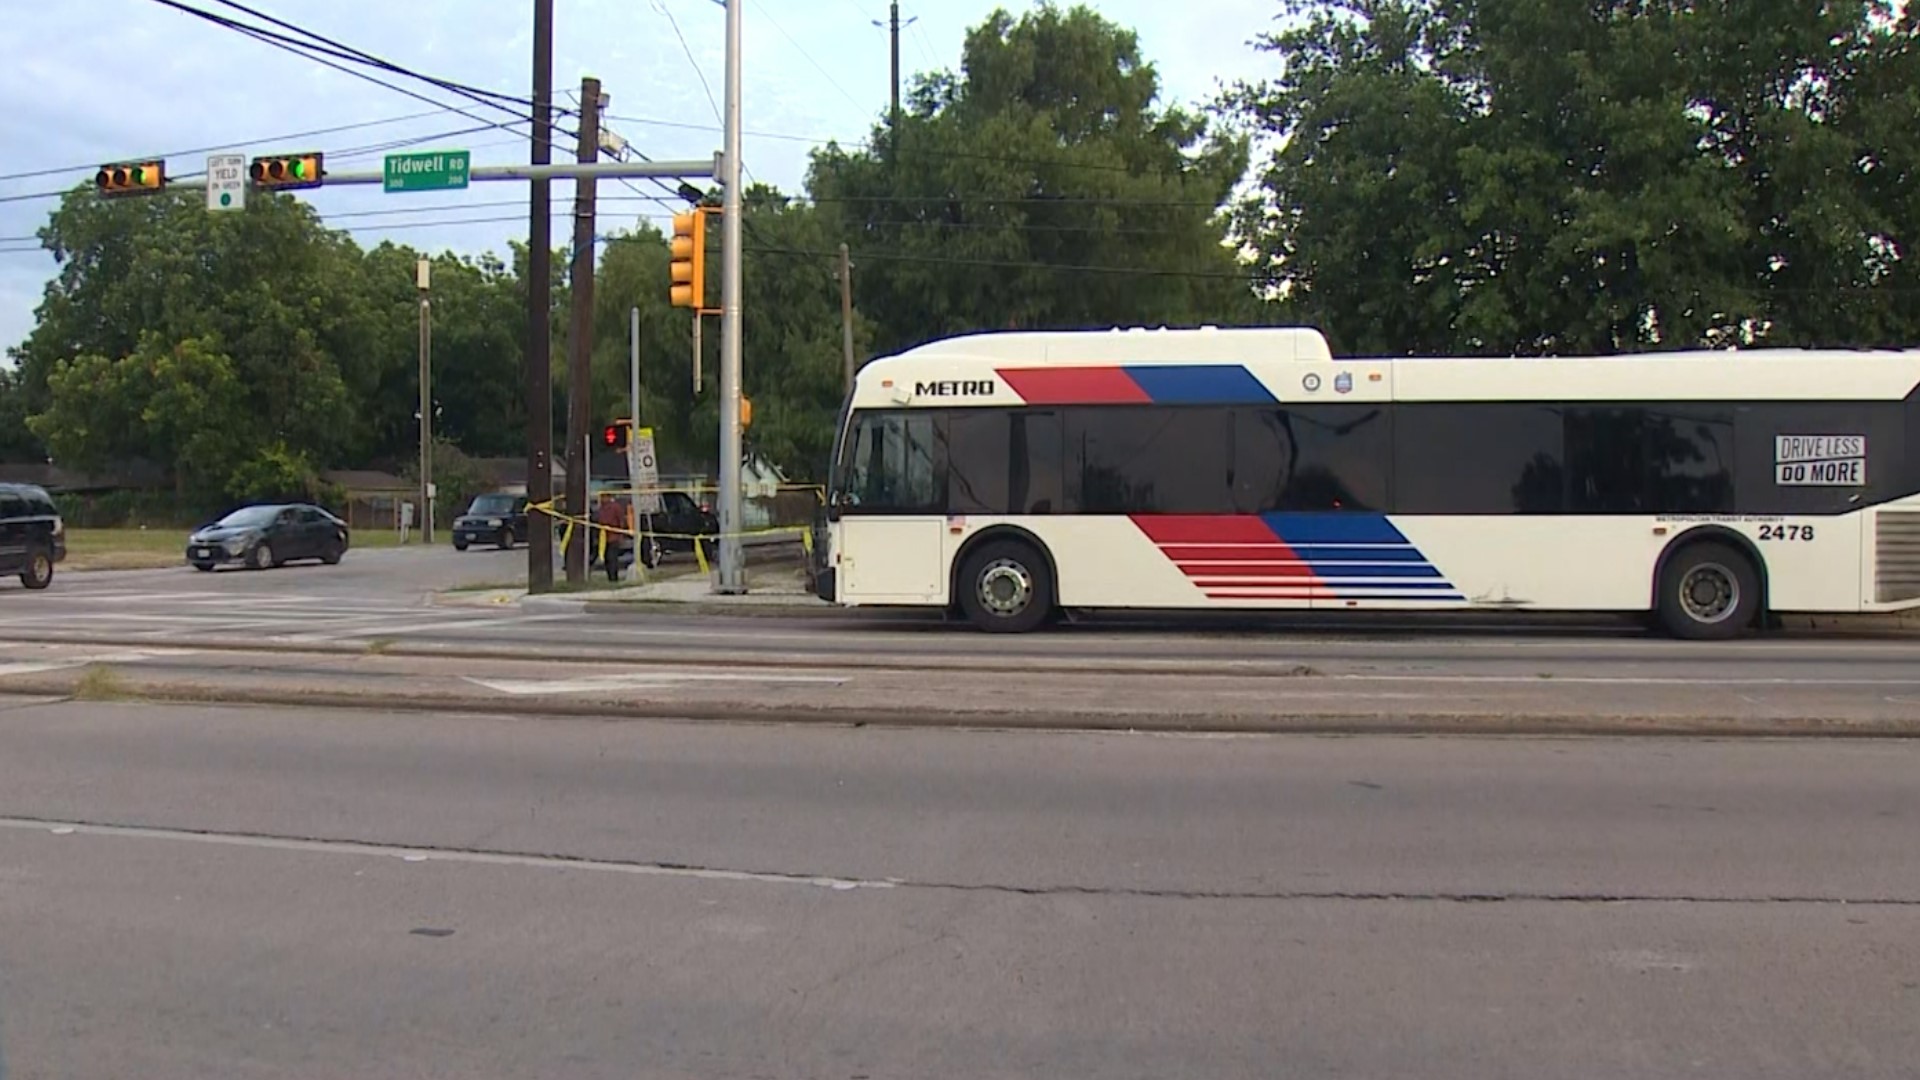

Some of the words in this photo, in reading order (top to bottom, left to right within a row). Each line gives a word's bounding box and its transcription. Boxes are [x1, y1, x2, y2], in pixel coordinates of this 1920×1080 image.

[389, 156, 444, 173] Tidwell
[450, 158, 464, 170] RD
[215, 168, 238, 180] YIELD
[915, 380, 994, 396] METRO
[1781, 438, 1822, 459] DRIVE
[1825, 438, 1860, 457] LESS
[1782, 465, 1805, 482] DO
[1810, 462, 1859, 482] MORE
[1758, 524, 1815, 541] 2478
